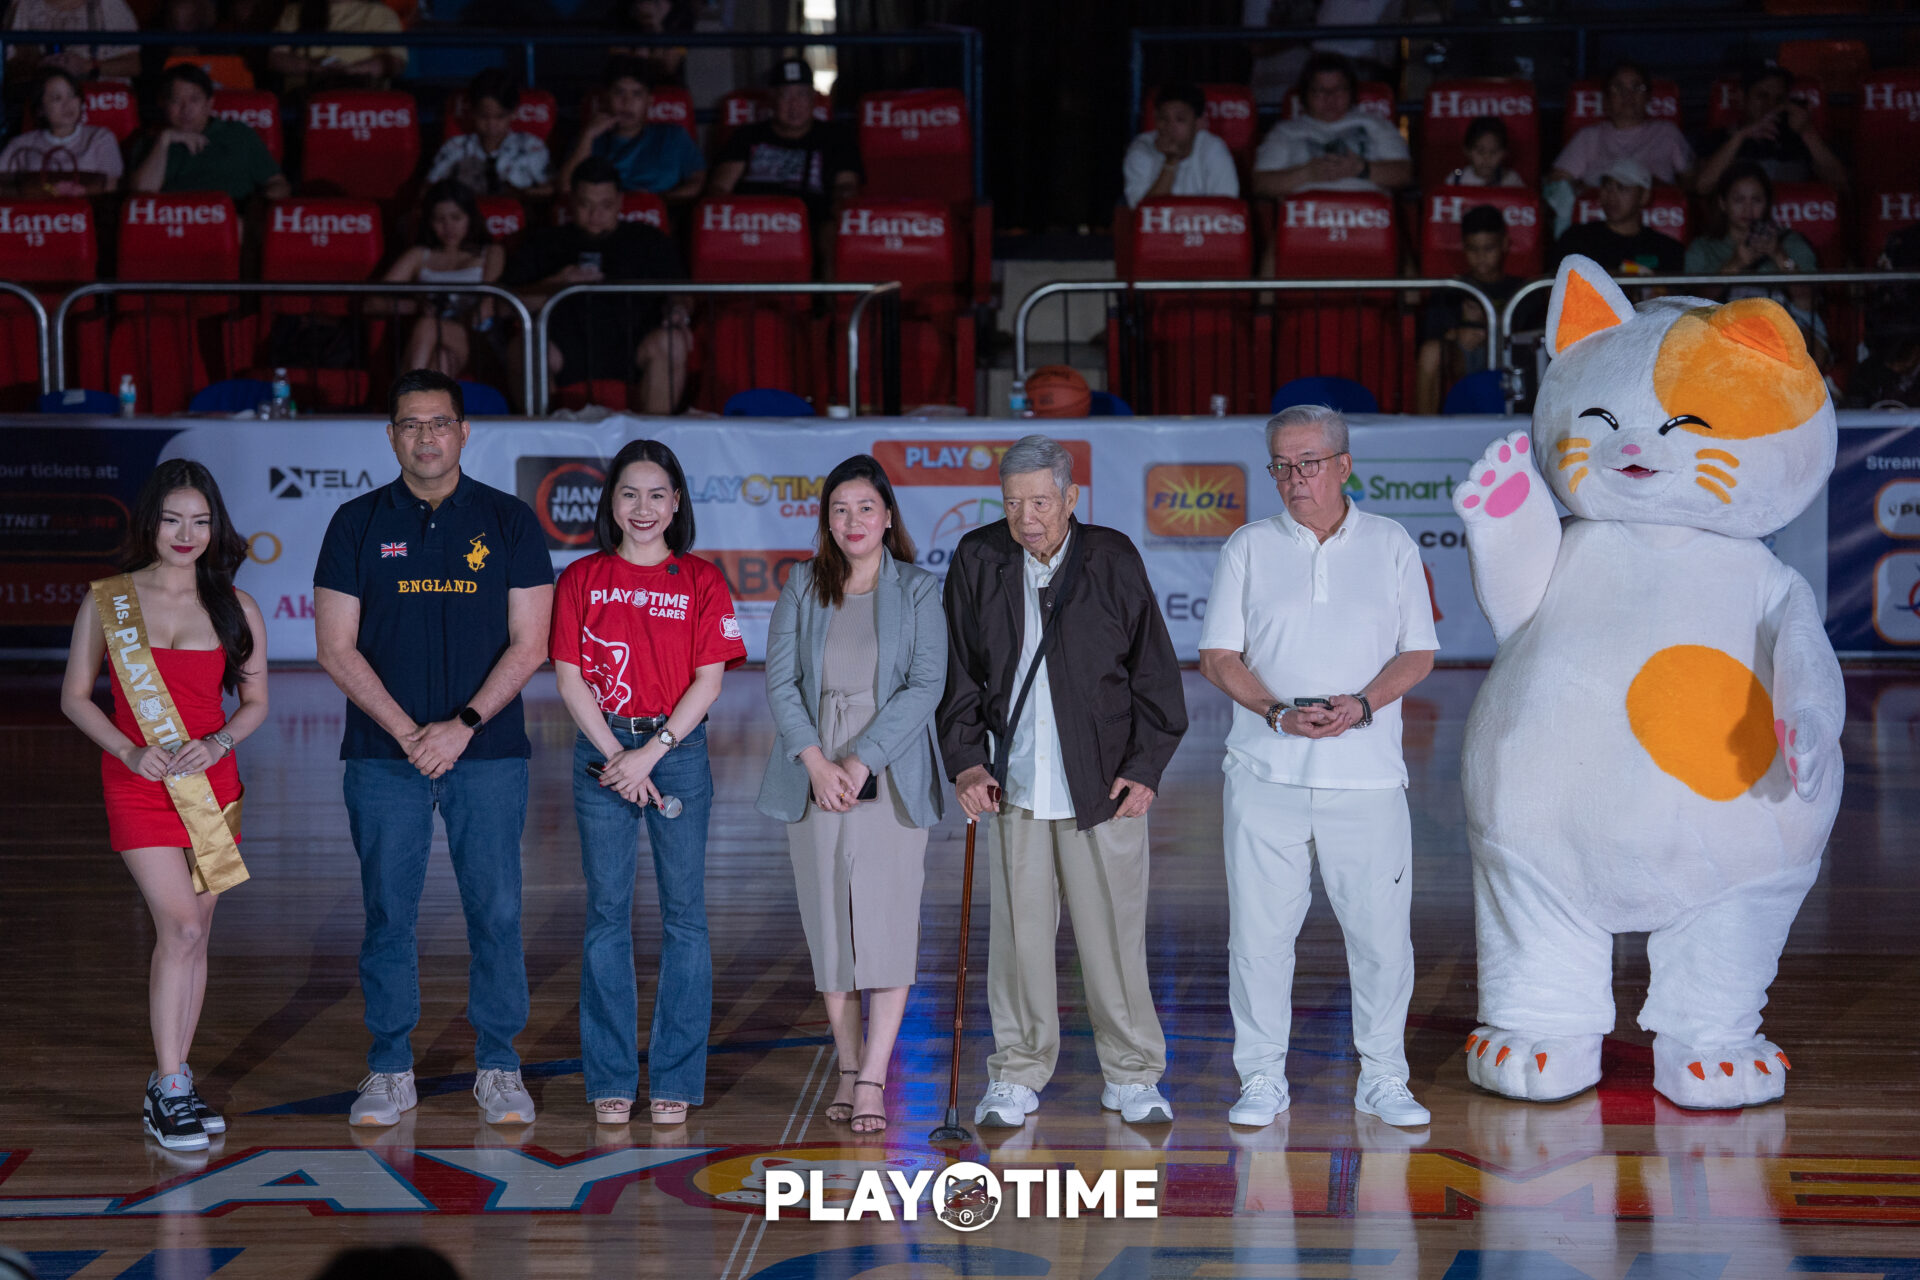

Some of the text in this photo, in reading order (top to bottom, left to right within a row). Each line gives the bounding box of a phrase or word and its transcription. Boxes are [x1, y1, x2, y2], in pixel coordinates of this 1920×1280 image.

[309, 103, 411, 131] Hanes
[863, 101, 960, 128] Hanes
[1431, 90, 1532, 118] Hanes
[1574, 90, 1677, 117] Hes
[127, 199, 226, 225] Hanes
[273, 206, 373, 234] Hanes
[702, 204, 802, 233] Hanes
[840, 209, 945, 237] Hanes
[1140, 206, 1243, 234] Hanes
[1285, 200, 1390, 228] Hanes
[1430, 196, 1535, 227] Hes
[0, 463, 119, 479] our tickets at:
[905, 447, 969, 469] PLAY
[687, 475, 827, 504] LAY TIM
[1152, 491, 1241, 510] FILOIL
[1369, 474, 1457, 501] Smart
[779, 505, 820, 518] CAR
[397, 579, 478, 594] ENGLAND
[590, 587, 691, 610] PLAY TIME
[112, 594, 131, 625] Ms.
[648, 606, 687, 621] CARES
[114, 626, 158, 693] PLAY
